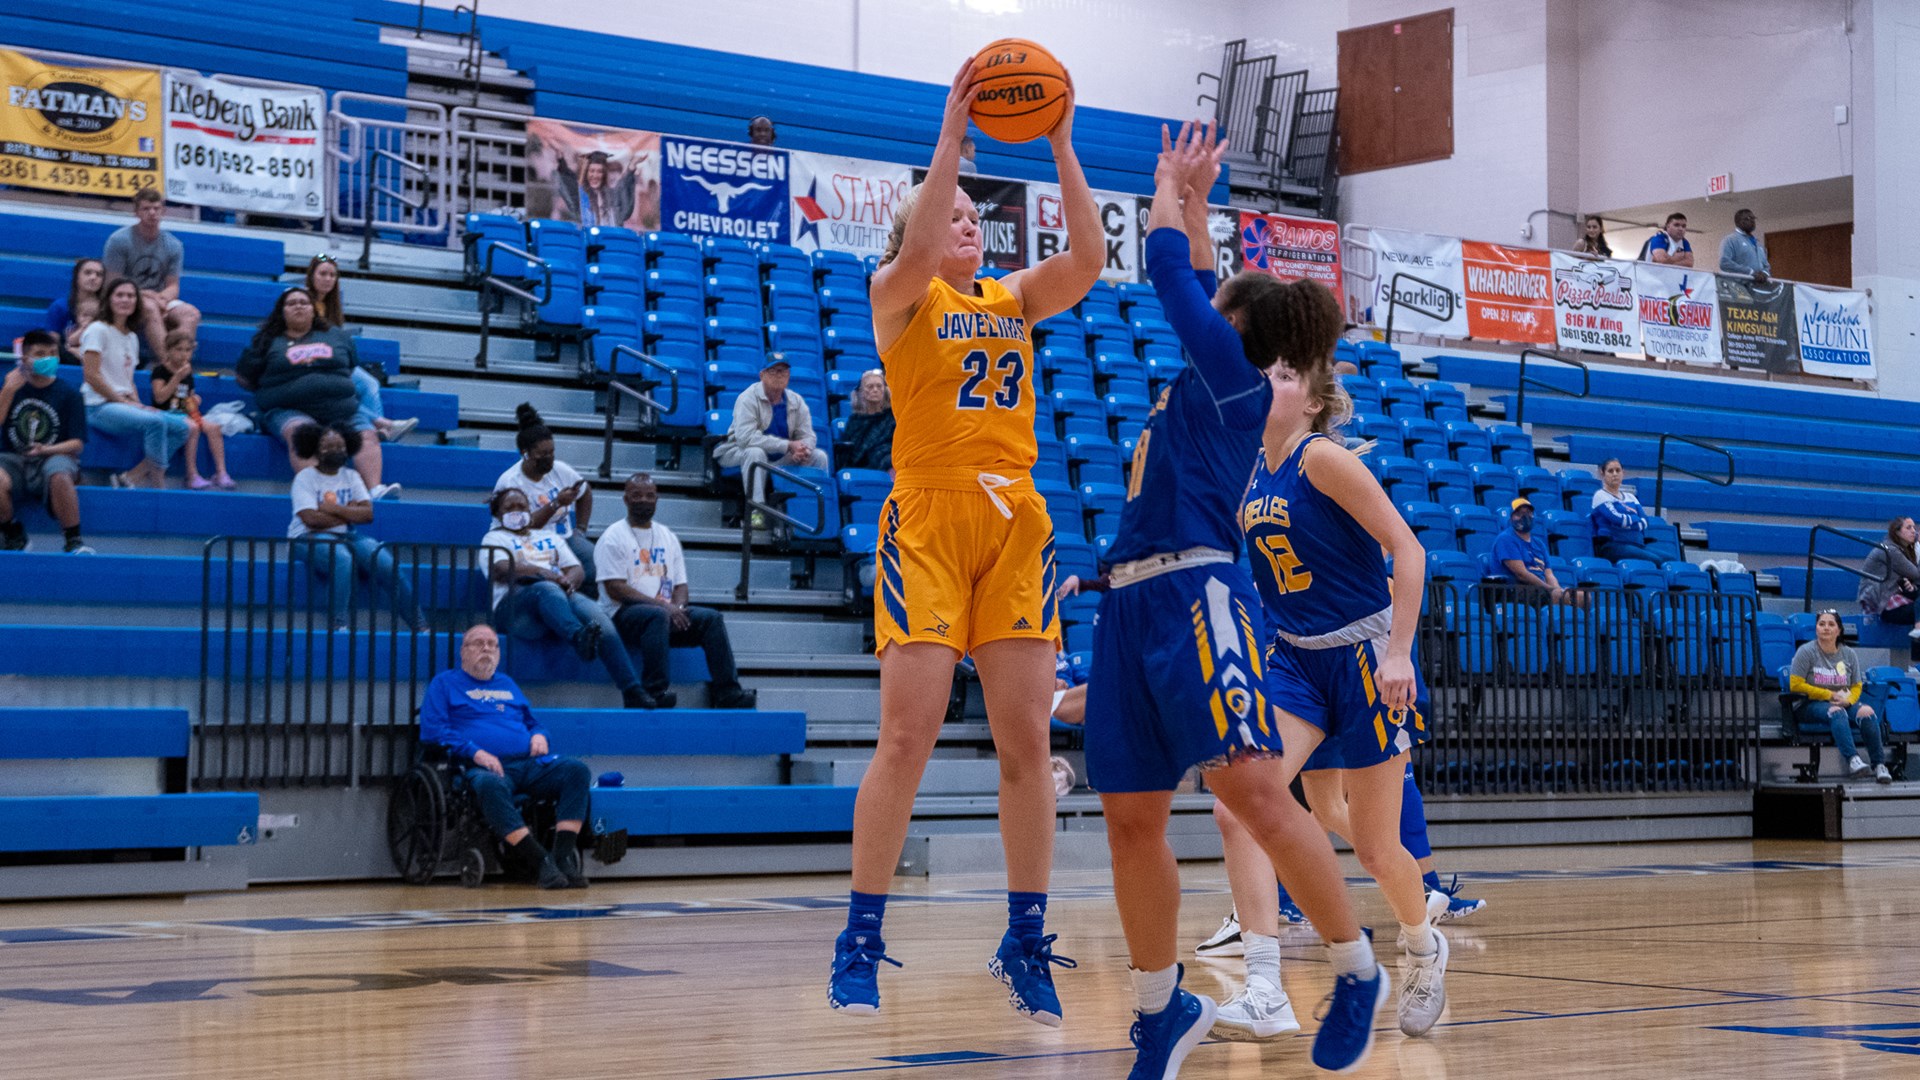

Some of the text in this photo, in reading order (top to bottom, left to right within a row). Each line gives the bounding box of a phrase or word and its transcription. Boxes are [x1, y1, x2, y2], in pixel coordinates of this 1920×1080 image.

[8, 85, 147, 122] FATMAN'S
[977, 82, 1046, 105] Wilson
[170, 81, 317, 142] Kleberg Bank
[0, 158, 156, 190] 361.459.4142
[174, 143, 315, 180] (361)592-8501
[665, 142, 786, 181] NEESSEN
[1710, 174, 1727, 192] EXIT
[673, 210, 780, 239] CHEVROLET
[980, 218, 1018, 254] OUSE
[1266, 221, 1337, 251] RAMOS
[1267, 248, 1334, 262] REFRIGERATION
[1467, 266, 1549, 300] WHATABURGER
[1557, 280, 1592, 305] Pizza
[1481, 307, 1536, 325] OPEN 24 HOURS
[1565, 312, 1623, 333] 816 W. King
[1638, 298, 1713, 328] MIKE SHAW
[1727, 307, 1759, 321] TEXAS
[1727, 320, 1778, 338] KINGSVILLE
[1801, 312, 1869, 349] ALUMNI
[1650, 340, 1707, 358] TOYOTA KIA
[1803, 349, 1869, 364] ASSOCIATION
[956, 349, 1025, 411] 23
[1244, 495, 1290, 533] BELLES
[1255, 534, 1313, 595] 12
